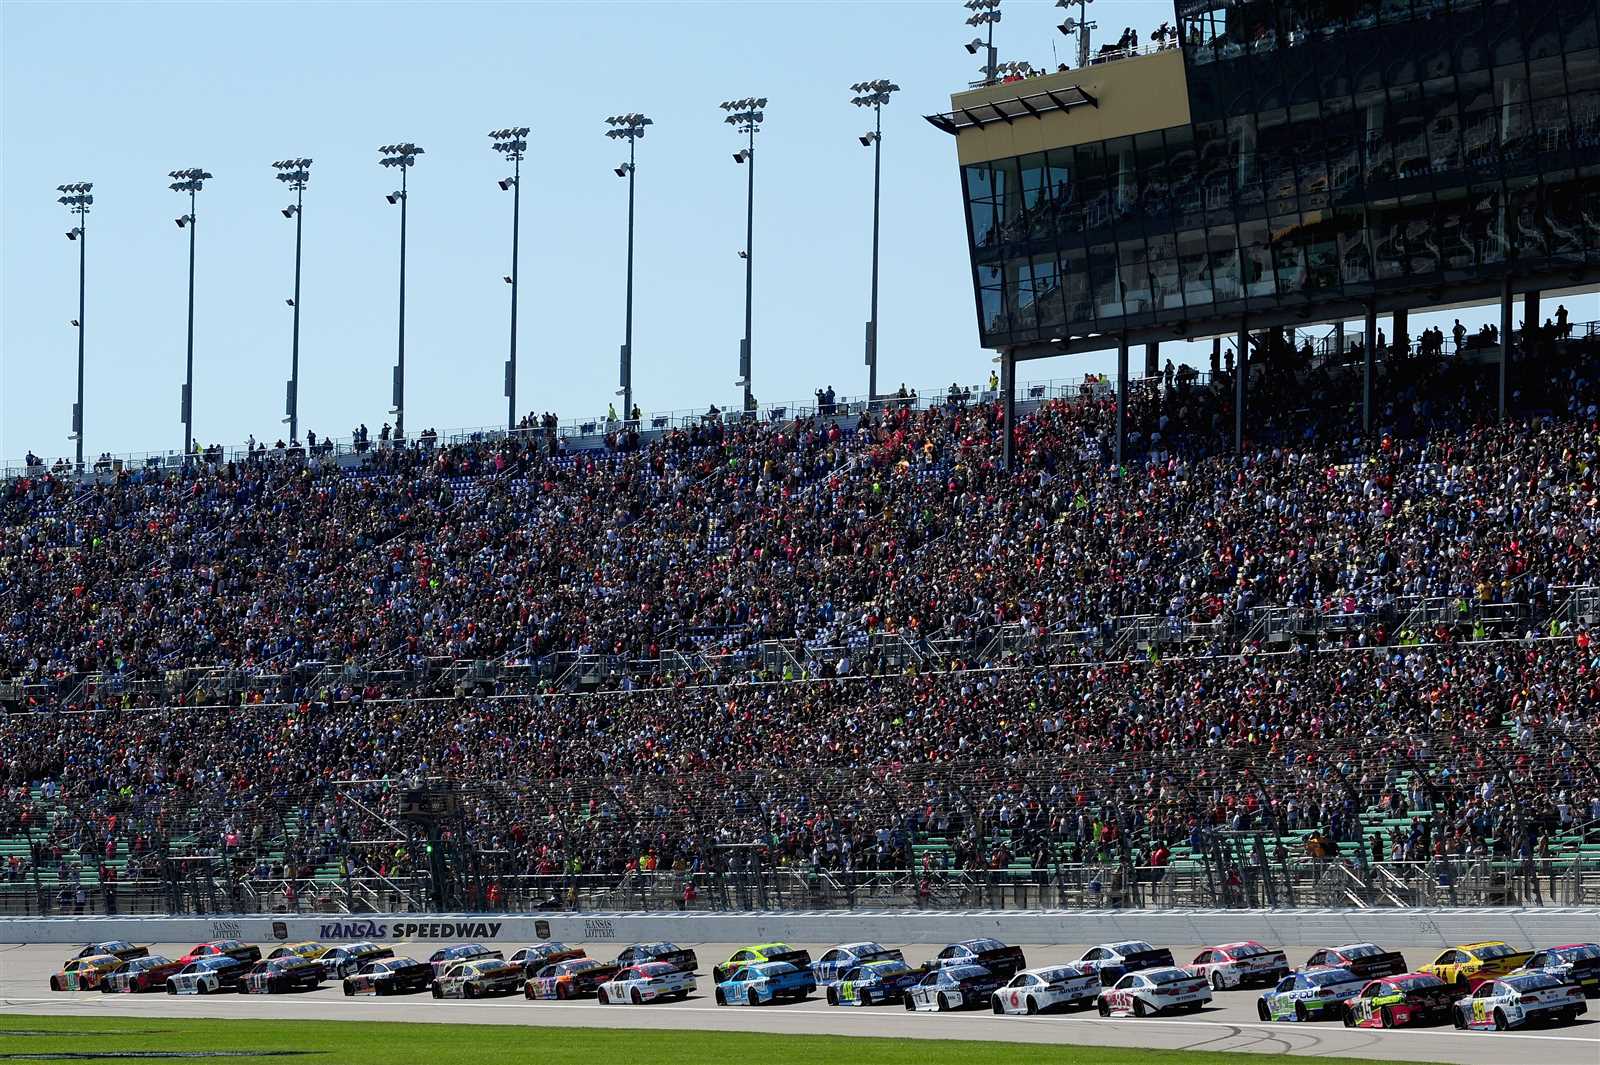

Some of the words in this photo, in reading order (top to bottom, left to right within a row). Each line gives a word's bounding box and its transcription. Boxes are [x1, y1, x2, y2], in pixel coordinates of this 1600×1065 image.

[213, 921, 240, 930] KANSAS
[320, 920, 387, 938] KANSAS
[392, 922, 502, 938] SPEEDWAY
[585, 920, 612, 929] KANSAS
[212, 930, 242, 939] LOTTERY
[584, 929, 615, 938] LOTTERY
[614, 983, 625, 998] 21
[842, 981, 855, 1000] 48
[1010, 991, 1019, 1008] 6
[1115, 992, 1127, 1008] 83
[1361, 999, 1372, 1020] 15
